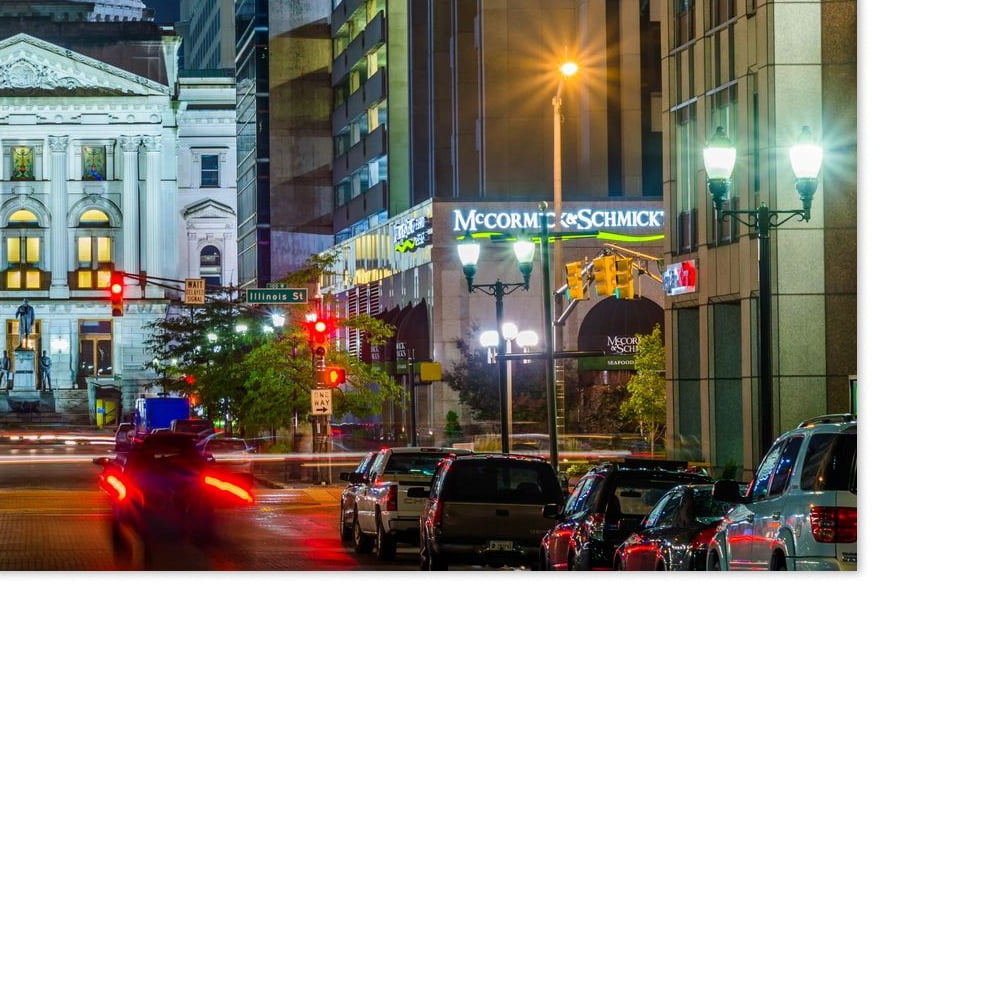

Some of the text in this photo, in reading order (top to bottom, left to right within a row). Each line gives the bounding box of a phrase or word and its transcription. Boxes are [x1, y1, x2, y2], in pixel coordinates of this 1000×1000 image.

[187, 280, 203, 289] WAIT
[249, 292, 304, 301] Illinois St
[607, 336, 641, 346] McCOR
